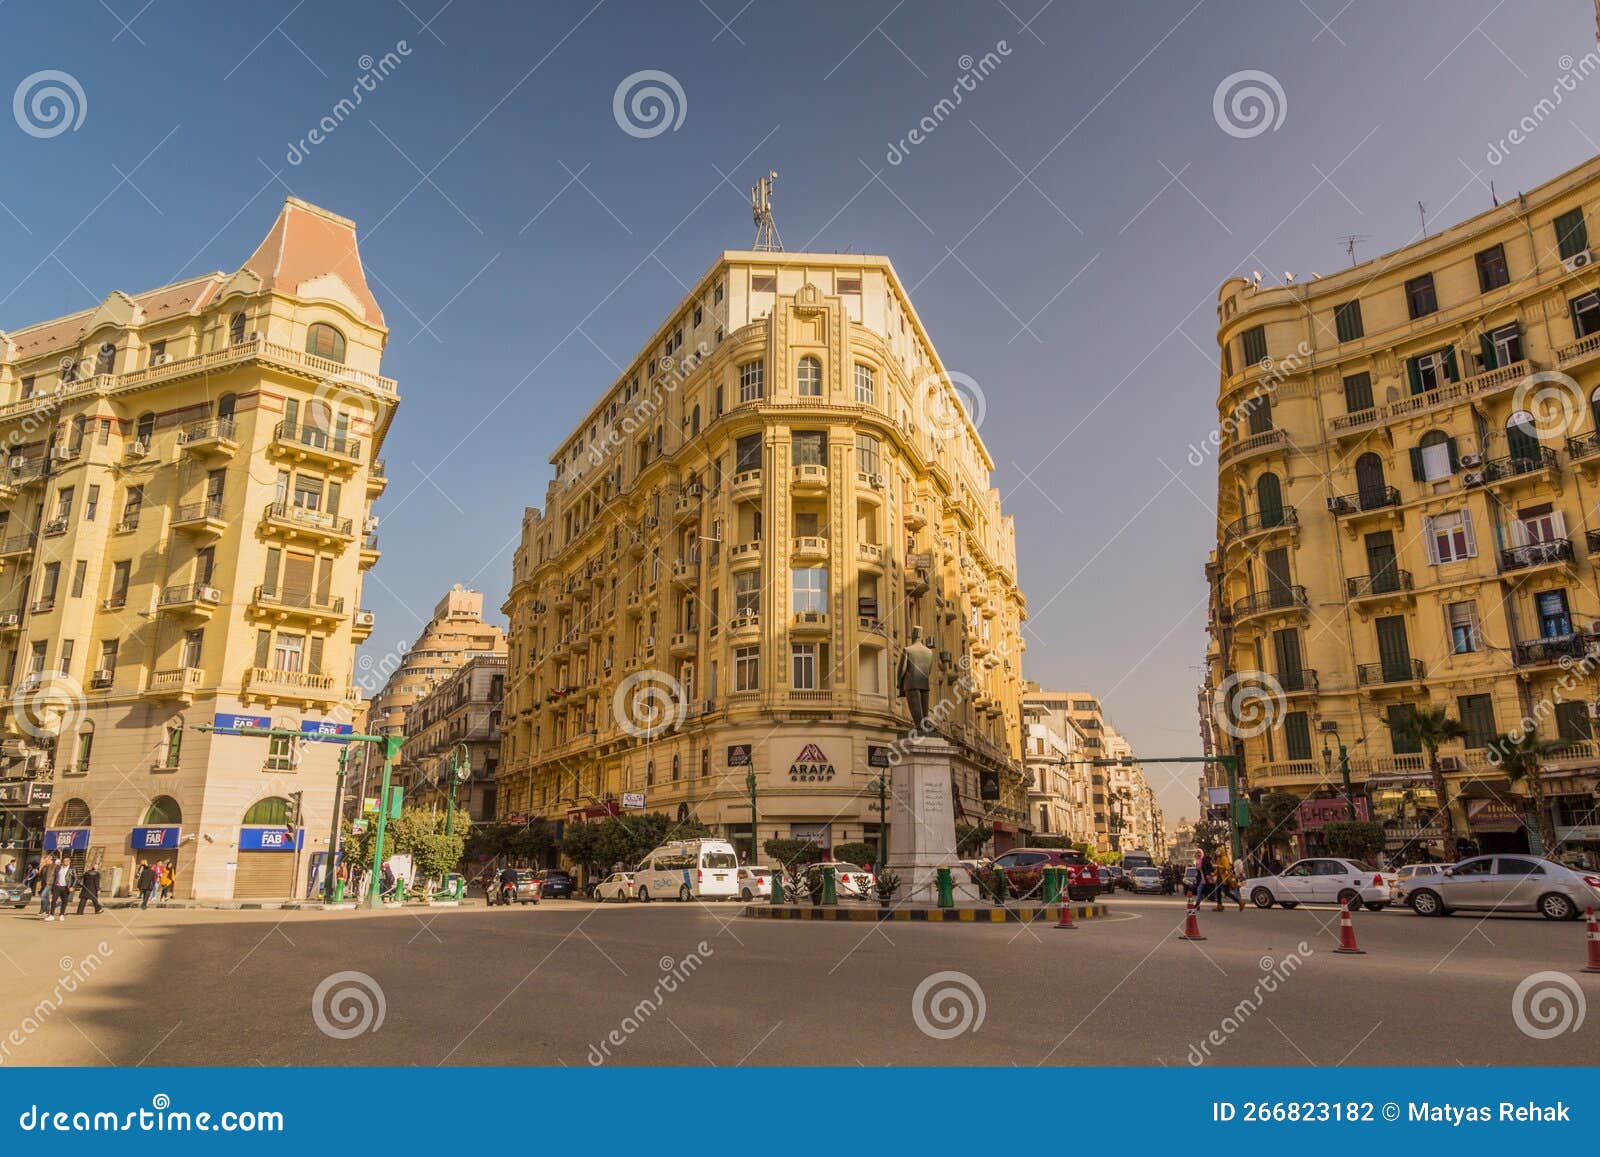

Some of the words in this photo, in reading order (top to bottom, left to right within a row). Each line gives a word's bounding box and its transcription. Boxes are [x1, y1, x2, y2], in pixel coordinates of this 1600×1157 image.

[788, 764, 836, 775] ARAFA
[1487, 803, 1517, 813] Hotel
[57, 834, 72, 845] FAB
[146, 833, 161, 844] FAB
[262, 834, 282, 844] FAB
